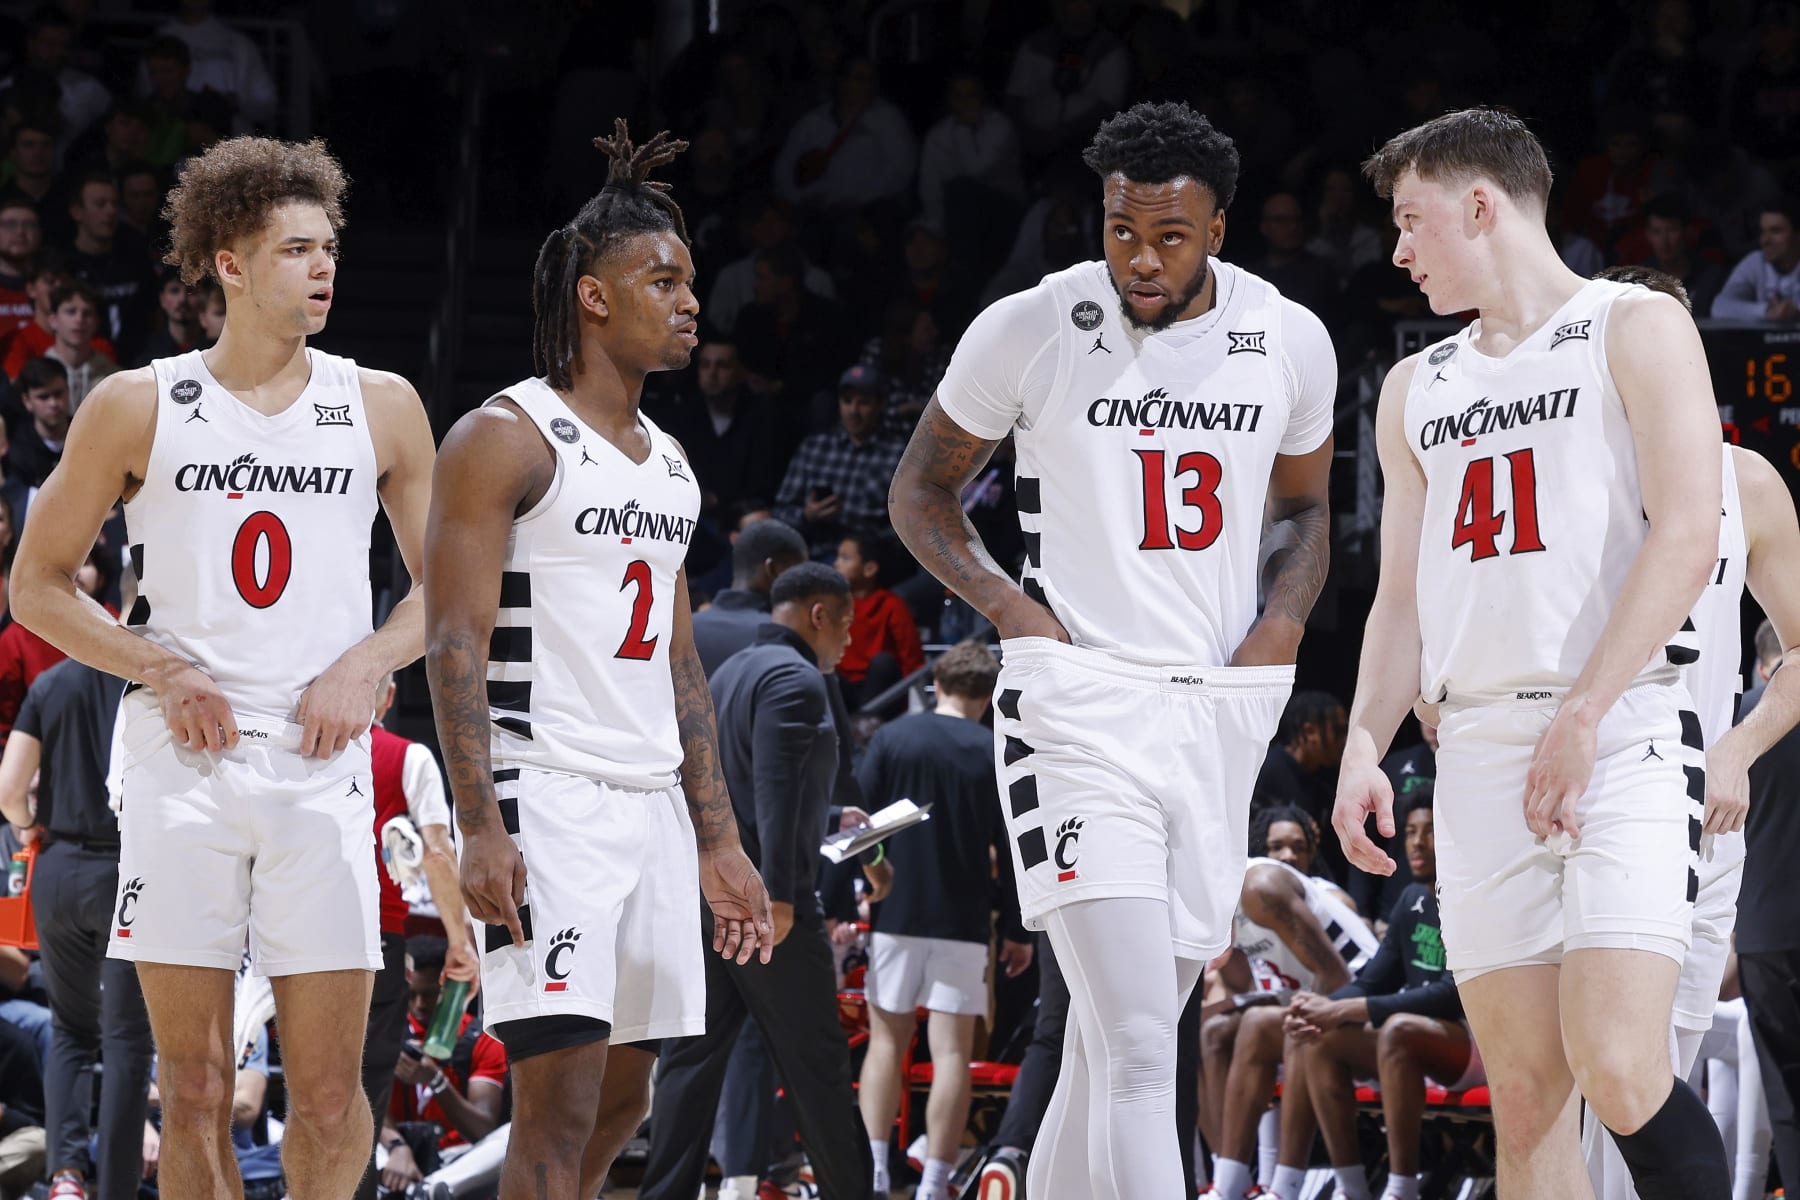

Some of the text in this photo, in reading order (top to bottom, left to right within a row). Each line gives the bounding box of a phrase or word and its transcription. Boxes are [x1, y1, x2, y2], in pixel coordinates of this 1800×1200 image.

[1746, 353, 1792, 403] 16
[1087, 393, 1263, 434] CINCINNATI
[1420, 388, 1581, 451] CINCINNATI
[176, 457, 354, 497] CINCINNATI
[1132, 449, 1223, 551] 13
[575, 502, 695, 545] CINCINNAT
[1452, 448, 1546, 562] 41
[231, 510, 292, 609] 0
[614, 560, 659, 661] 2
[1171, 676, 1204, 685] BEARCATS
[1517, 692, 1552, 700] BEARCATS
[239, 729, 268, 738] EARCATS
